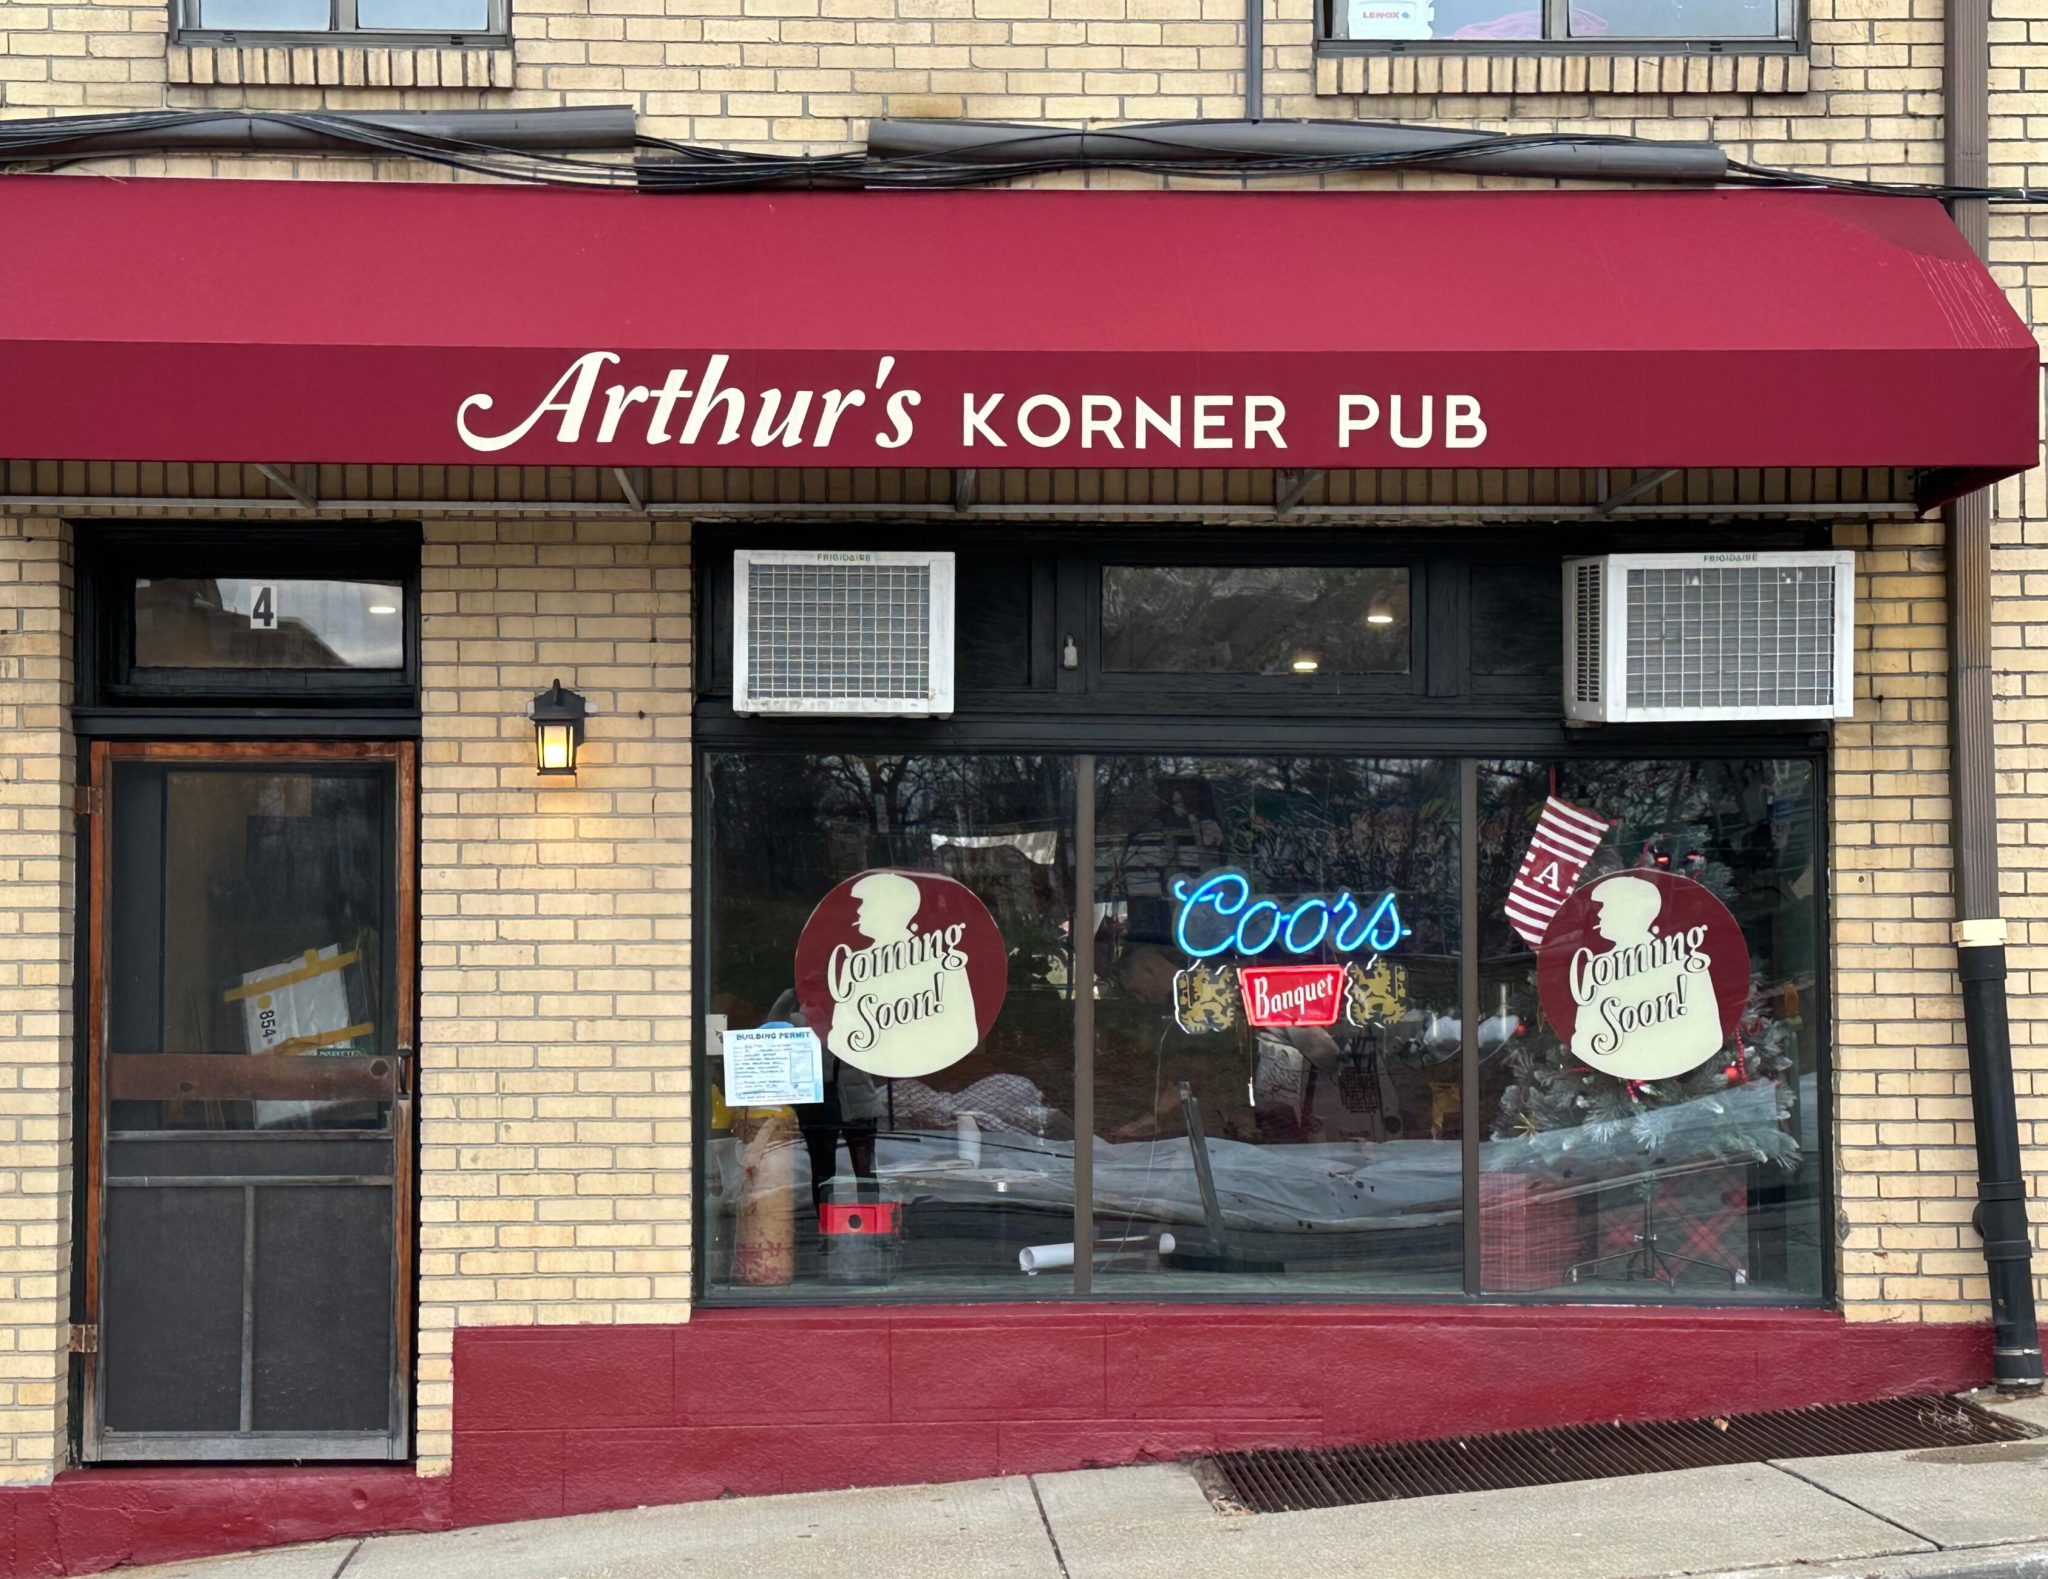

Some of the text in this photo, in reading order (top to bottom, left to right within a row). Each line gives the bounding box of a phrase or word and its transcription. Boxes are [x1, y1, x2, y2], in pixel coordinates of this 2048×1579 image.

[1362, 11, 1400, 19] LENOX
[456, 351, 1488, 452] Arthur's KORNER PUB
[816, 552, 871, 562] FRIGIDAIRE
[1703, 554, 1758, 563] FRIGIDAIRE
[252, 587, 274, 627] 4
[1533, 861, 1561, 892] A
[1173, 872, 1412, 958] Coors
[827, 922, 969, 1004] Coming
[1569, 924, 1712, 1007] Coming
[847, 972, 945, 1052] Soon!
[1253, 973, 1335, 1020] Banquet
[1590, 974, 1688, 1055] Soon!
[259, 1009, 278, 1039] 854
[736, 1031, 811, 1041] BUILDING PERMIT
